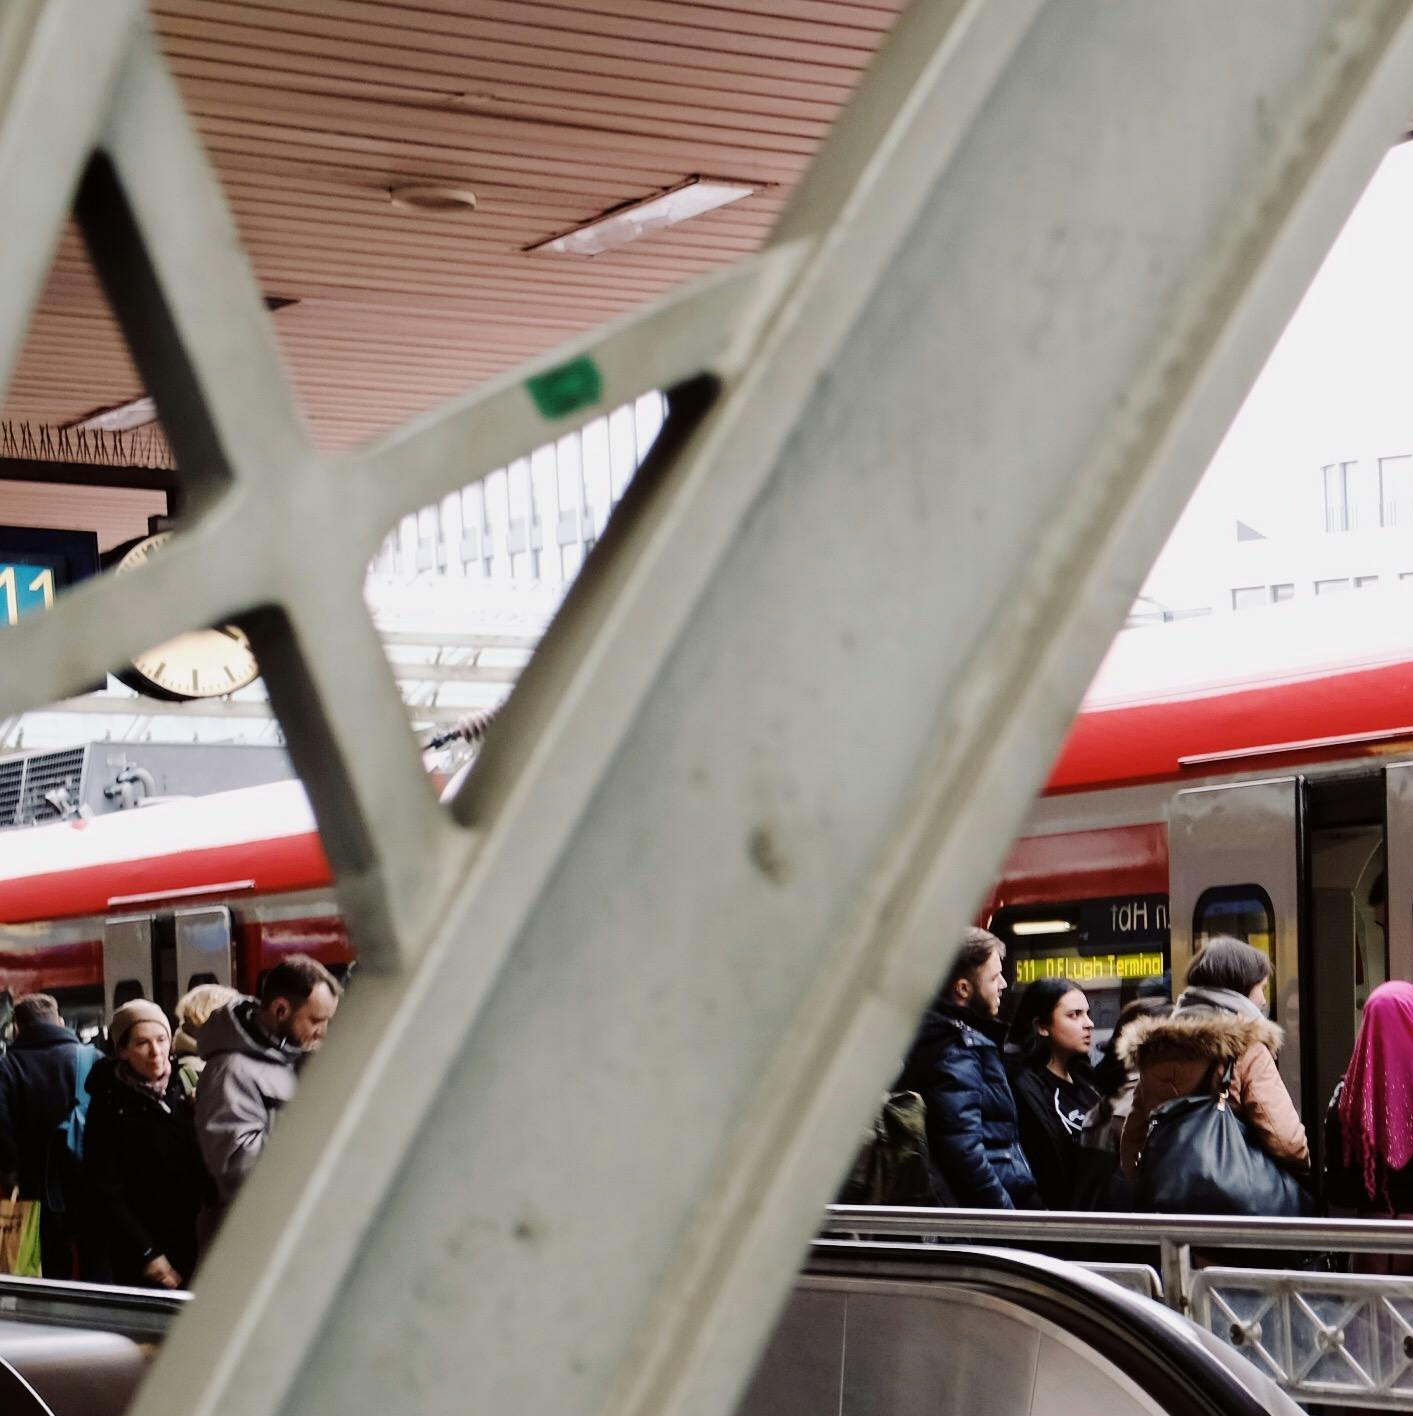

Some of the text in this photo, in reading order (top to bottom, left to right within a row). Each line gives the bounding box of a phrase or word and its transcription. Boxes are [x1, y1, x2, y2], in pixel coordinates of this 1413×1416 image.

[0, 566, 54, 626] 11
[1016, 958, 1035, 982] S11
[1107, 951, 1164, 978] Terminal
